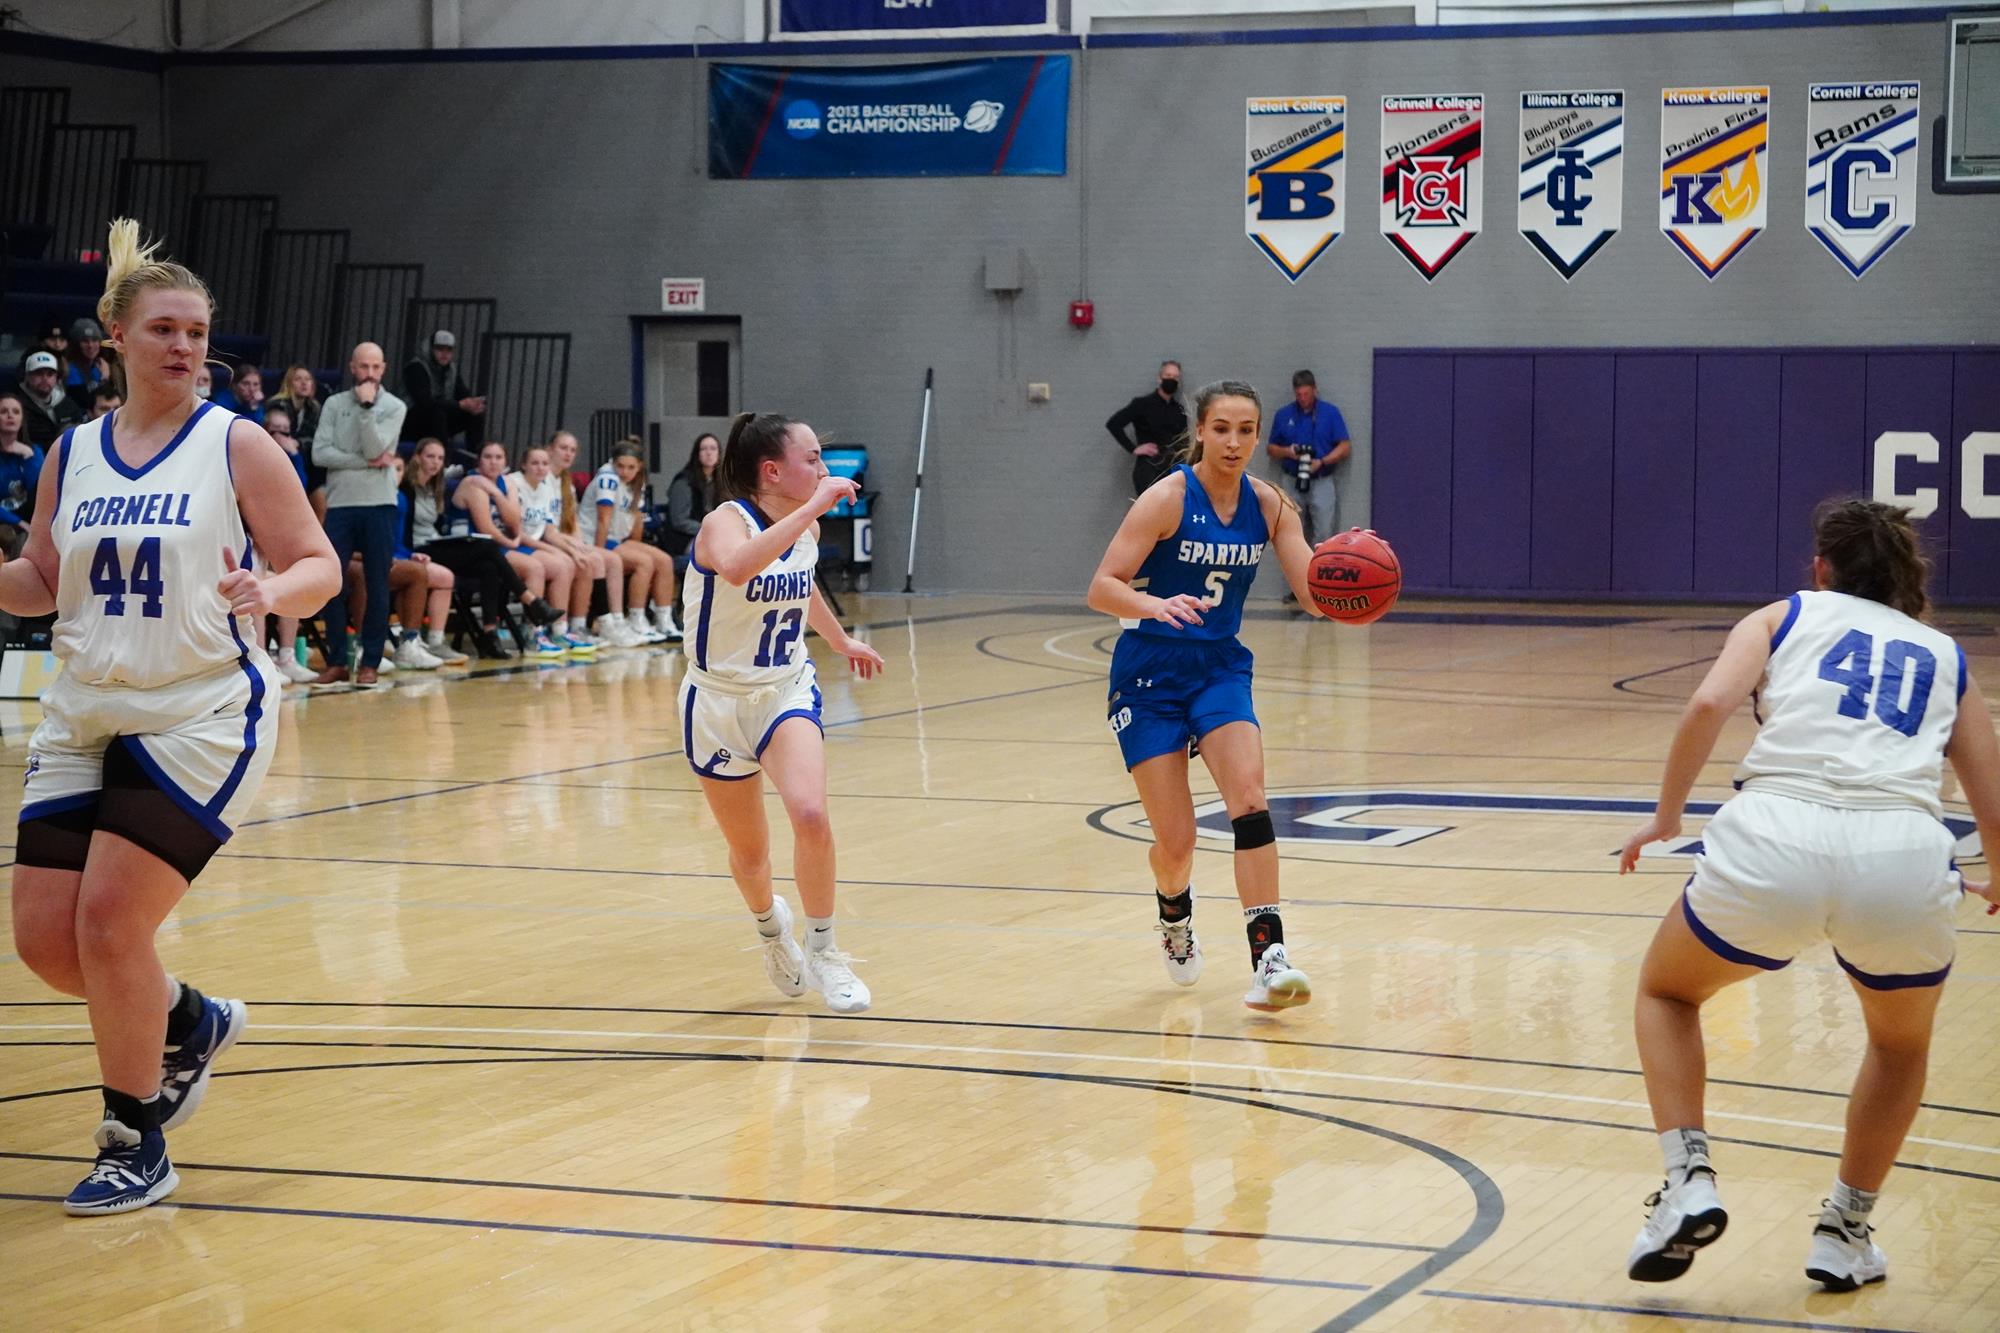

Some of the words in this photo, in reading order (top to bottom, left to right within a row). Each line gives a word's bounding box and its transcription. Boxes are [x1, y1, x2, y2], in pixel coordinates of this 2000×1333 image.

[1249, 102, 1290, 113] Beloit
[1292, 100, 1342, 114] College
[1385, 99, 1433, 110] Grinnell
[1435, 97, 1481, 110] College
[1527, 94, 1568, 106] Illinois
[1571, 93, 1617, 108] College
[1668, 92, 1705, 103] Knox
[1710, 91, 1762, 106] College
[1811, 86, 1861, 99] Cornell
[1865, 84, 1918, 99] College
[787, 118, 820, 130] NCAA
[827, 105, 860, 118] 2013
[863, 104, 954, 117] BASKETBALL
[827, 117, 961, 134] CHAMPIONSHIP
[1524, 110, 1579, 141] Blueboys
[1814, 104, 1896, 149] Rams
[1250, 117, 1332, 162] Buccaneers
[1385, 113, 1470, 159] Pioneers
[1526, 138, 1556, 155] Lady
[1559, 119, 1594, 140] Blues
[1665, 126, 1720, 156] Prairie
[1724, 107, 1759, 128] Fire
[1257, 171, 1335, 220] B
[1414, 171, 1448, 210] G
[1671, 175, 1724, 224] K
[1827, 145, 1895, 233] C
[668, 290, 698, 305] EXIT
[72, 493, 192, 533] CORNELL
[1178, 539, 1264, 566] SPARTANS
[89, 537, 164, 619] 44
[745, 567, 815, 603] CORNEL
[1201, 571, 1232, 607] 5
[753, 607, 803, 668] 12
[1817, 628, 1937, 738] 40
